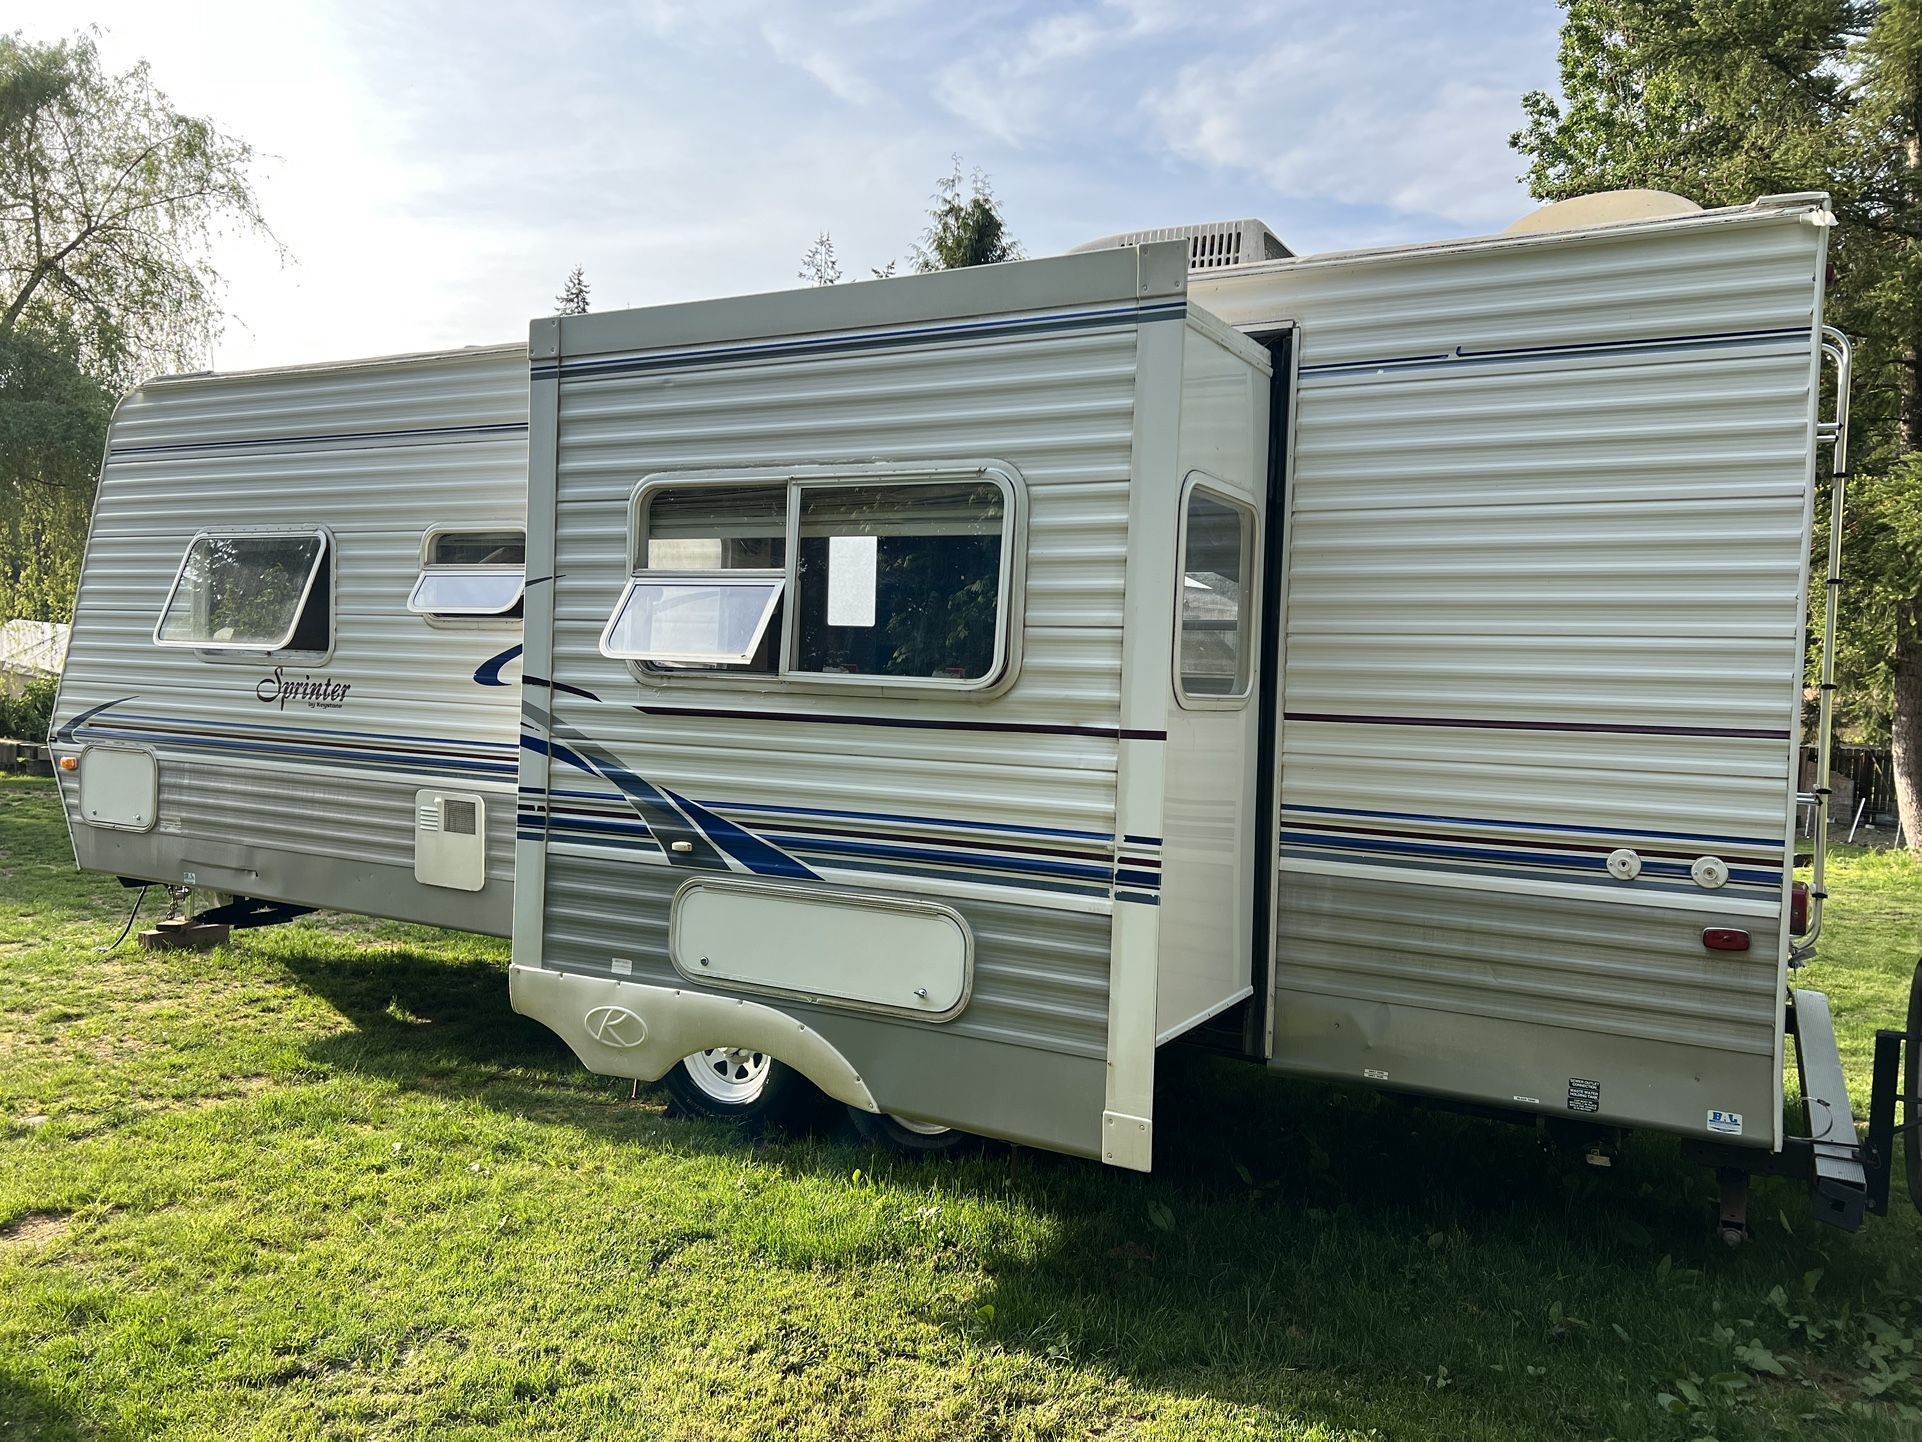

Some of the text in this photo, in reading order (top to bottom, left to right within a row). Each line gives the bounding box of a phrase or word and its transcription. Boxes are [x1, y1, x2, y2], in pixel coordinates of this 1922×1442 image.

[256, 666, 351, 711] Sprinter
[308, 701, 342, 710] by Keystone
